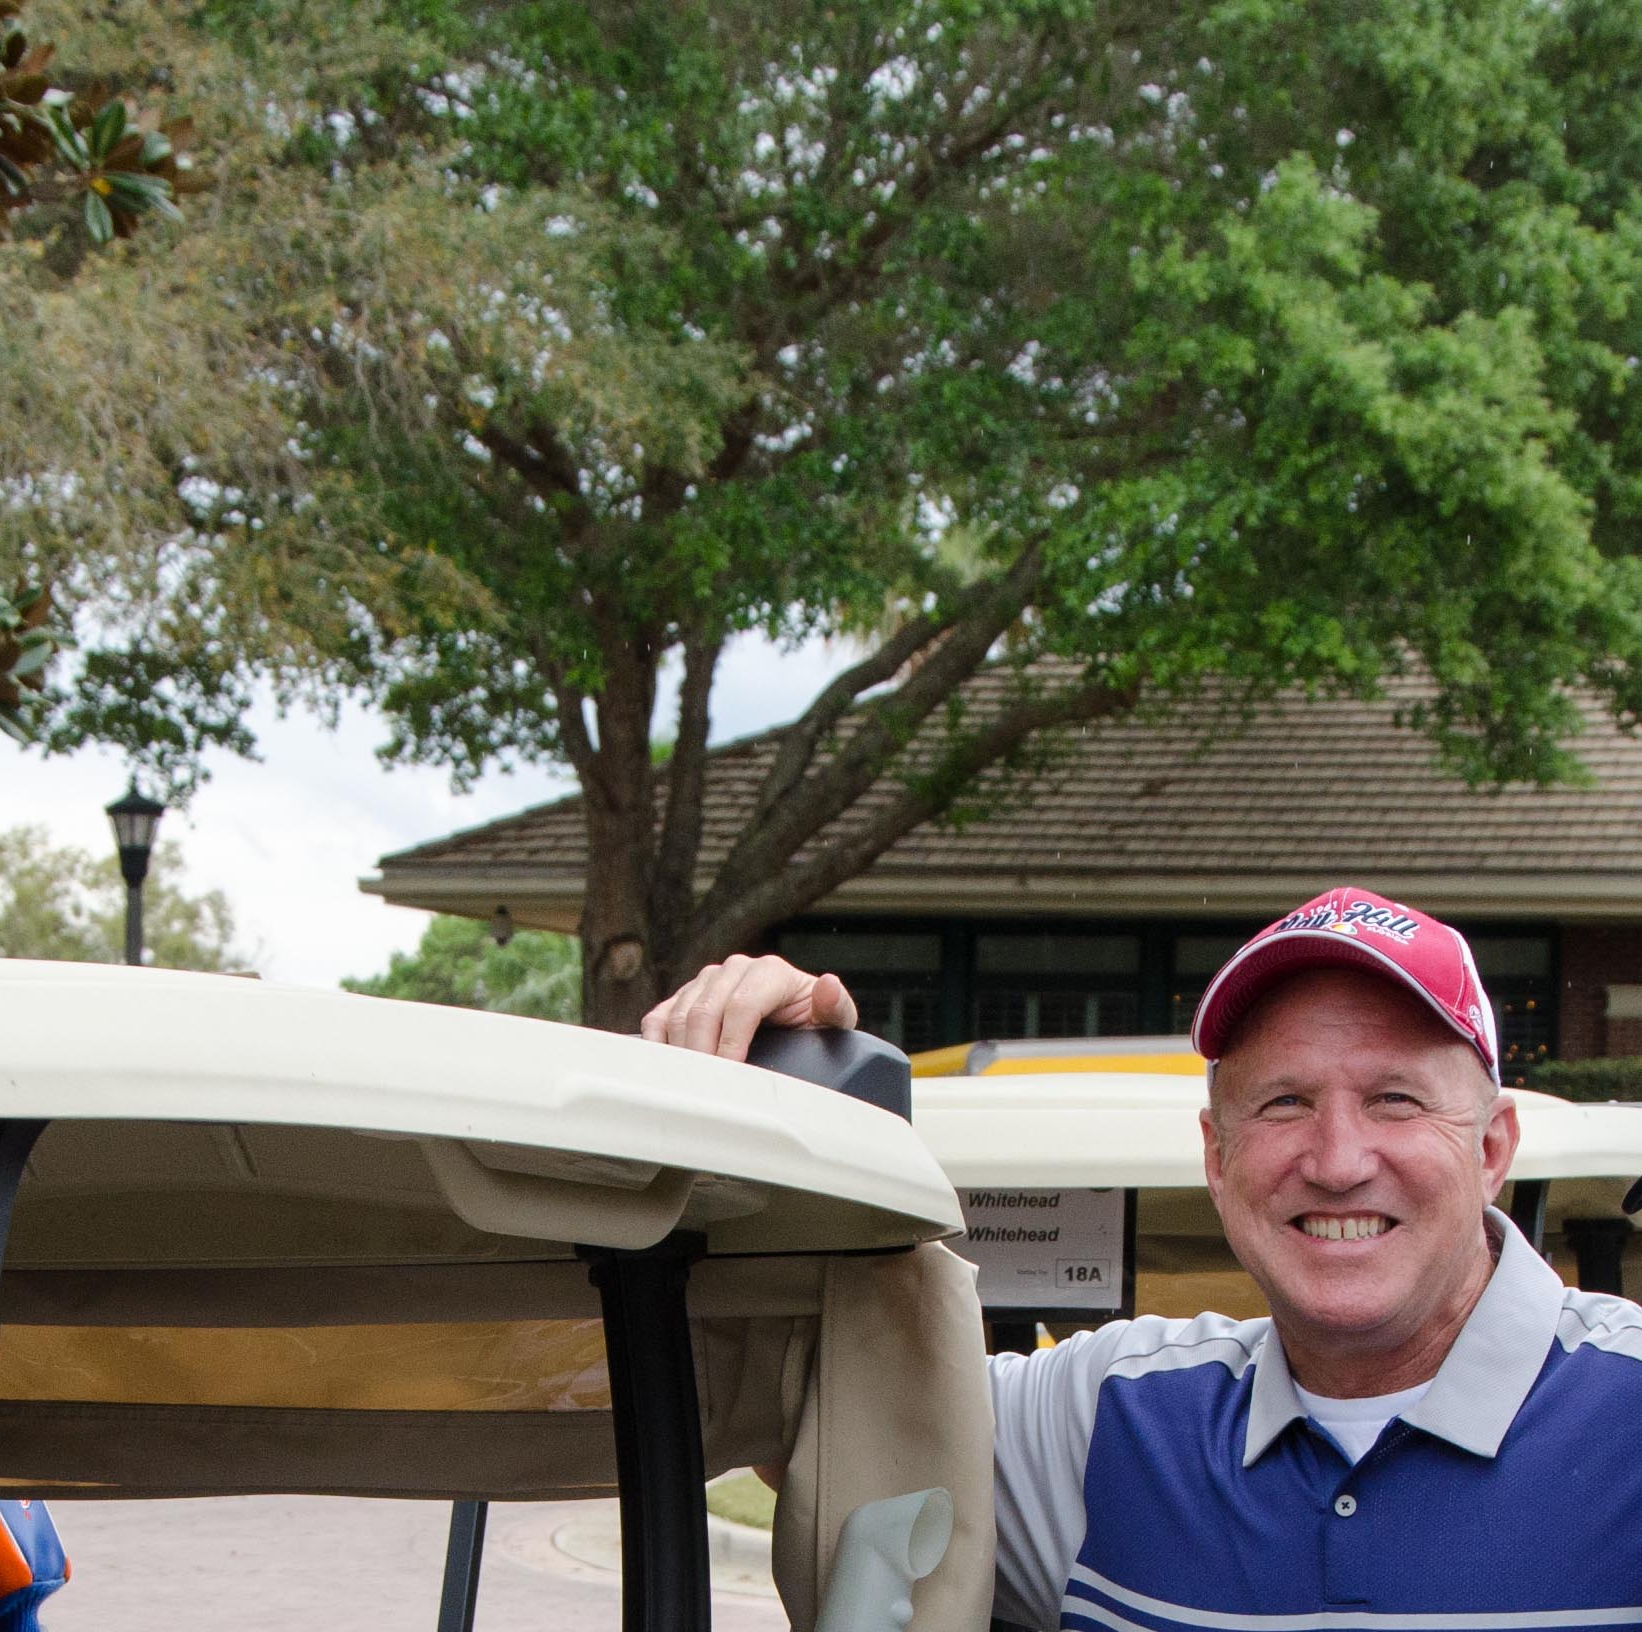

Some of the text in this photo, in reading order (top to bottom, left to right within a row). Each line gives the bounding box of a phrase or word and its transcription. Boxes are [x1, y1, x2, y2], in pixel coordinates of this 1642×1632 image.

[1342, 902, 1419, 938] Hill
[968, 1192, 1060, 1208] Whitehead
[968, 1226, 1060, 1242] Whitehead
[1064, 1266, 1102, 1282] 18A
